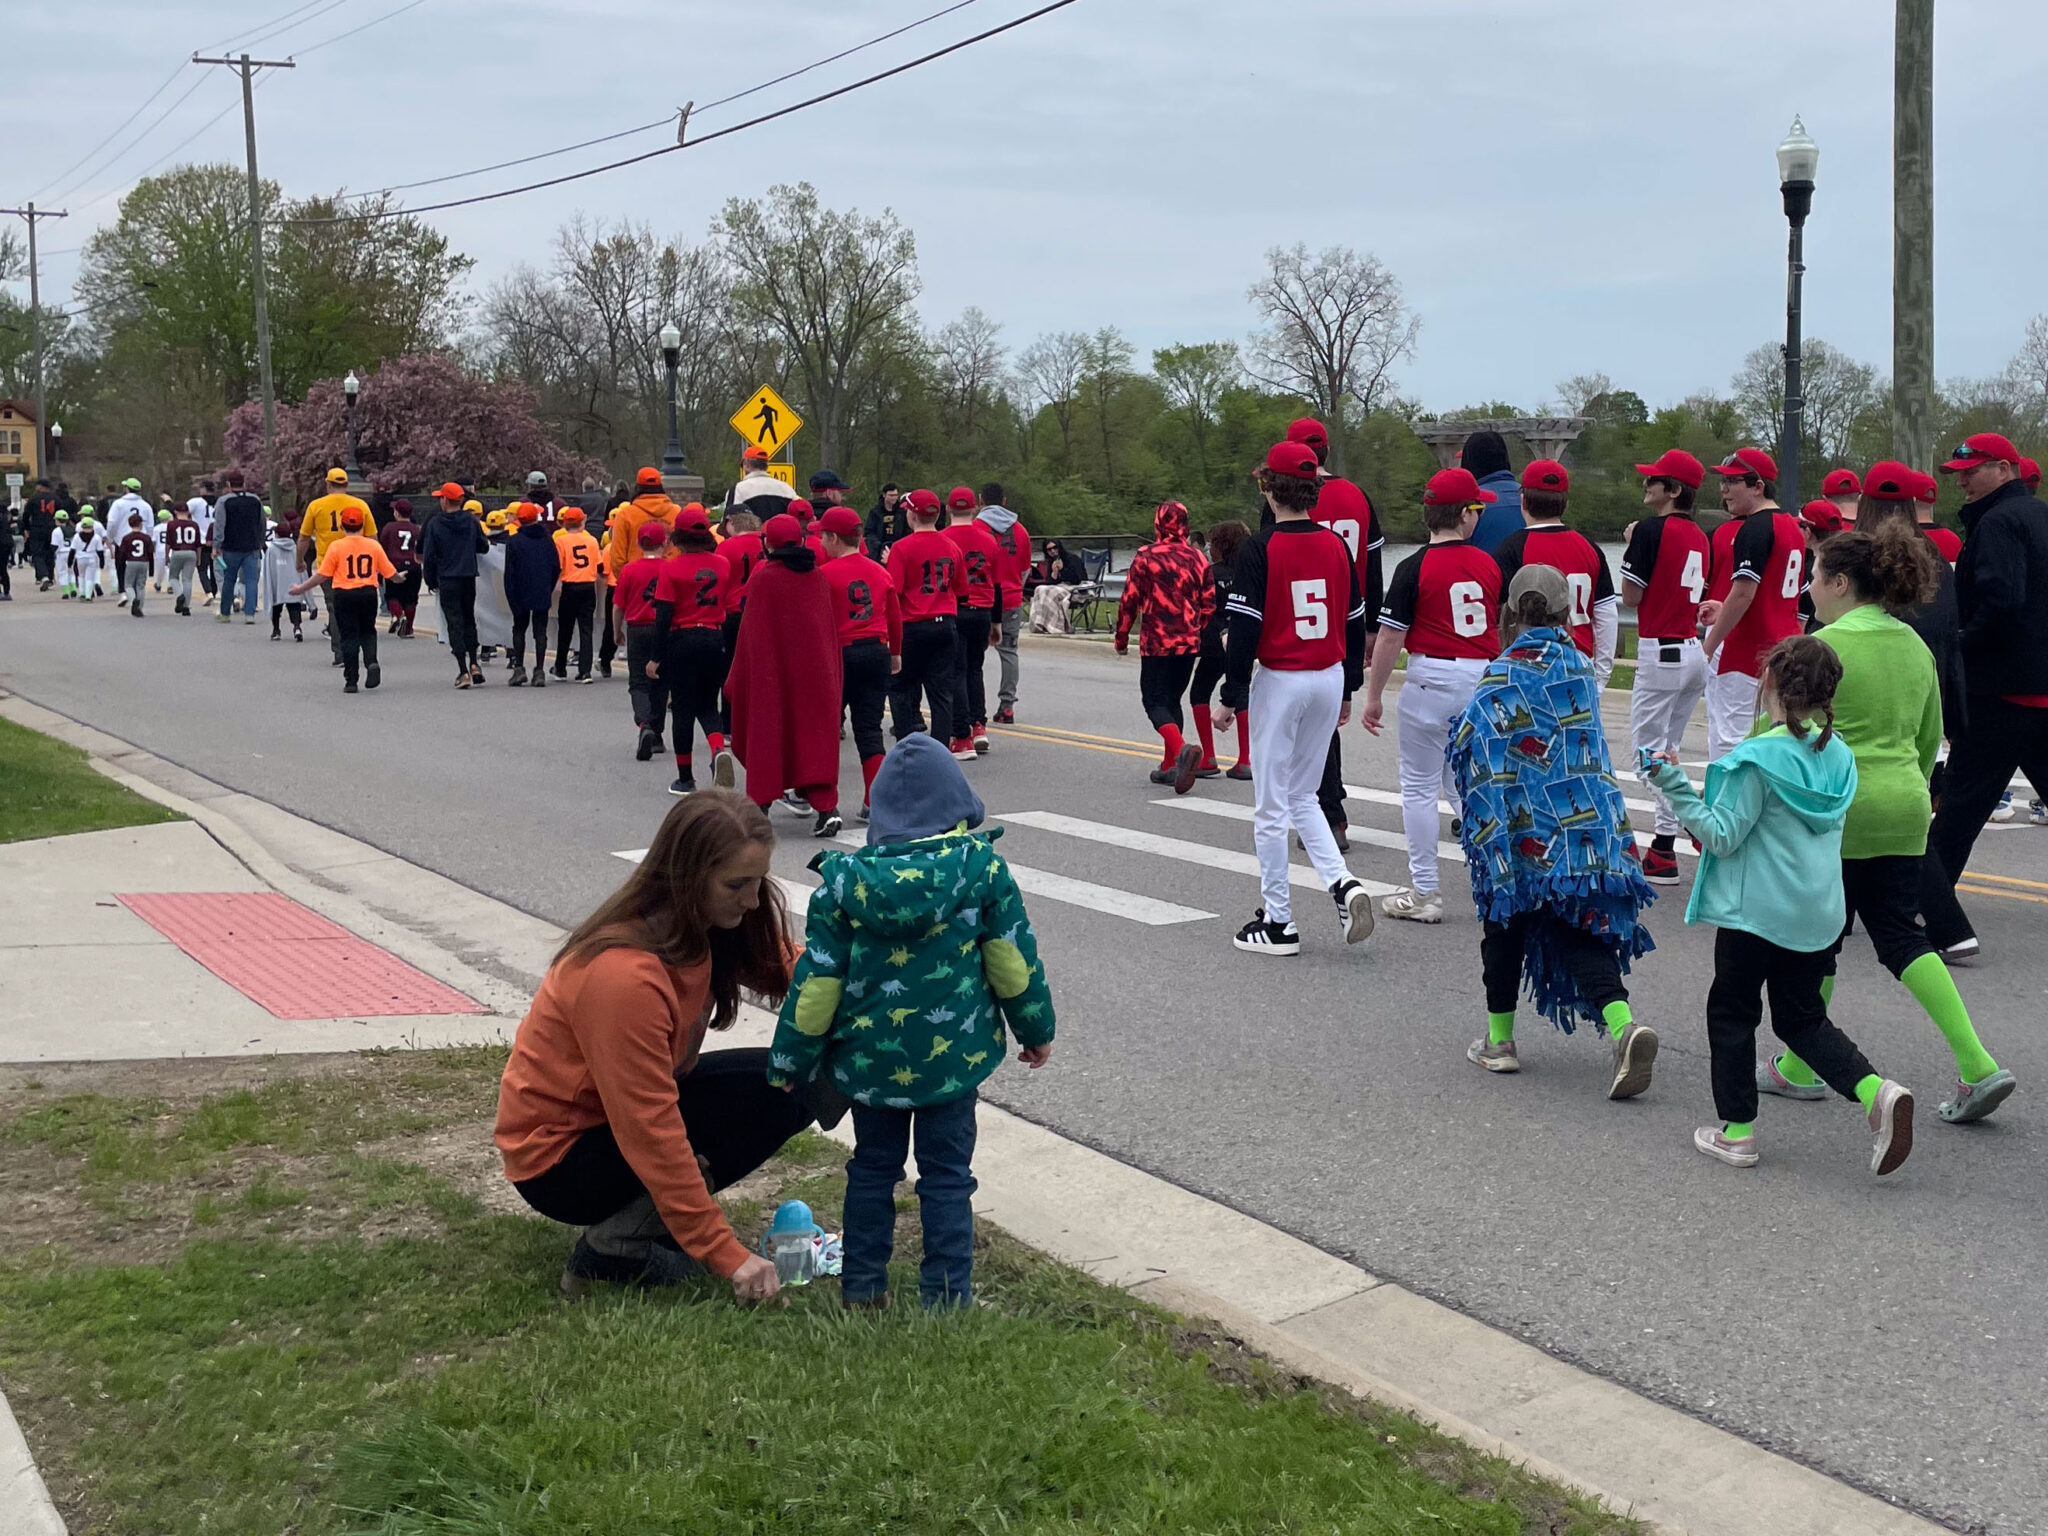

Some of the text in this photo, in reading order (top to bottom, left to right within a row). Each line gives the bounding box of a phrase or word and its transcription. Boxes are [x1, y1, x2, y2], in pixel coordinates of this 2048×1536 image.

[131, 539, 145, 557] 3
[175, 526, 196, 544] 10
[398, 530, 412, 550] 7
[346, 553, 373, 579] 10
[572, 544, 590, 569] 5
[965, 551, 987, 584] 2
[1781, 549, 1803, 599] 8
[695, 568, 718, 607] 2
[920, 557, 954, 595] 10
[1680, 549, 1705, 604] 4
[848, 579, 874, 621] 9
[1291, 578, 1329, 640] 5
[1449, 580, 1488, 638] 6
